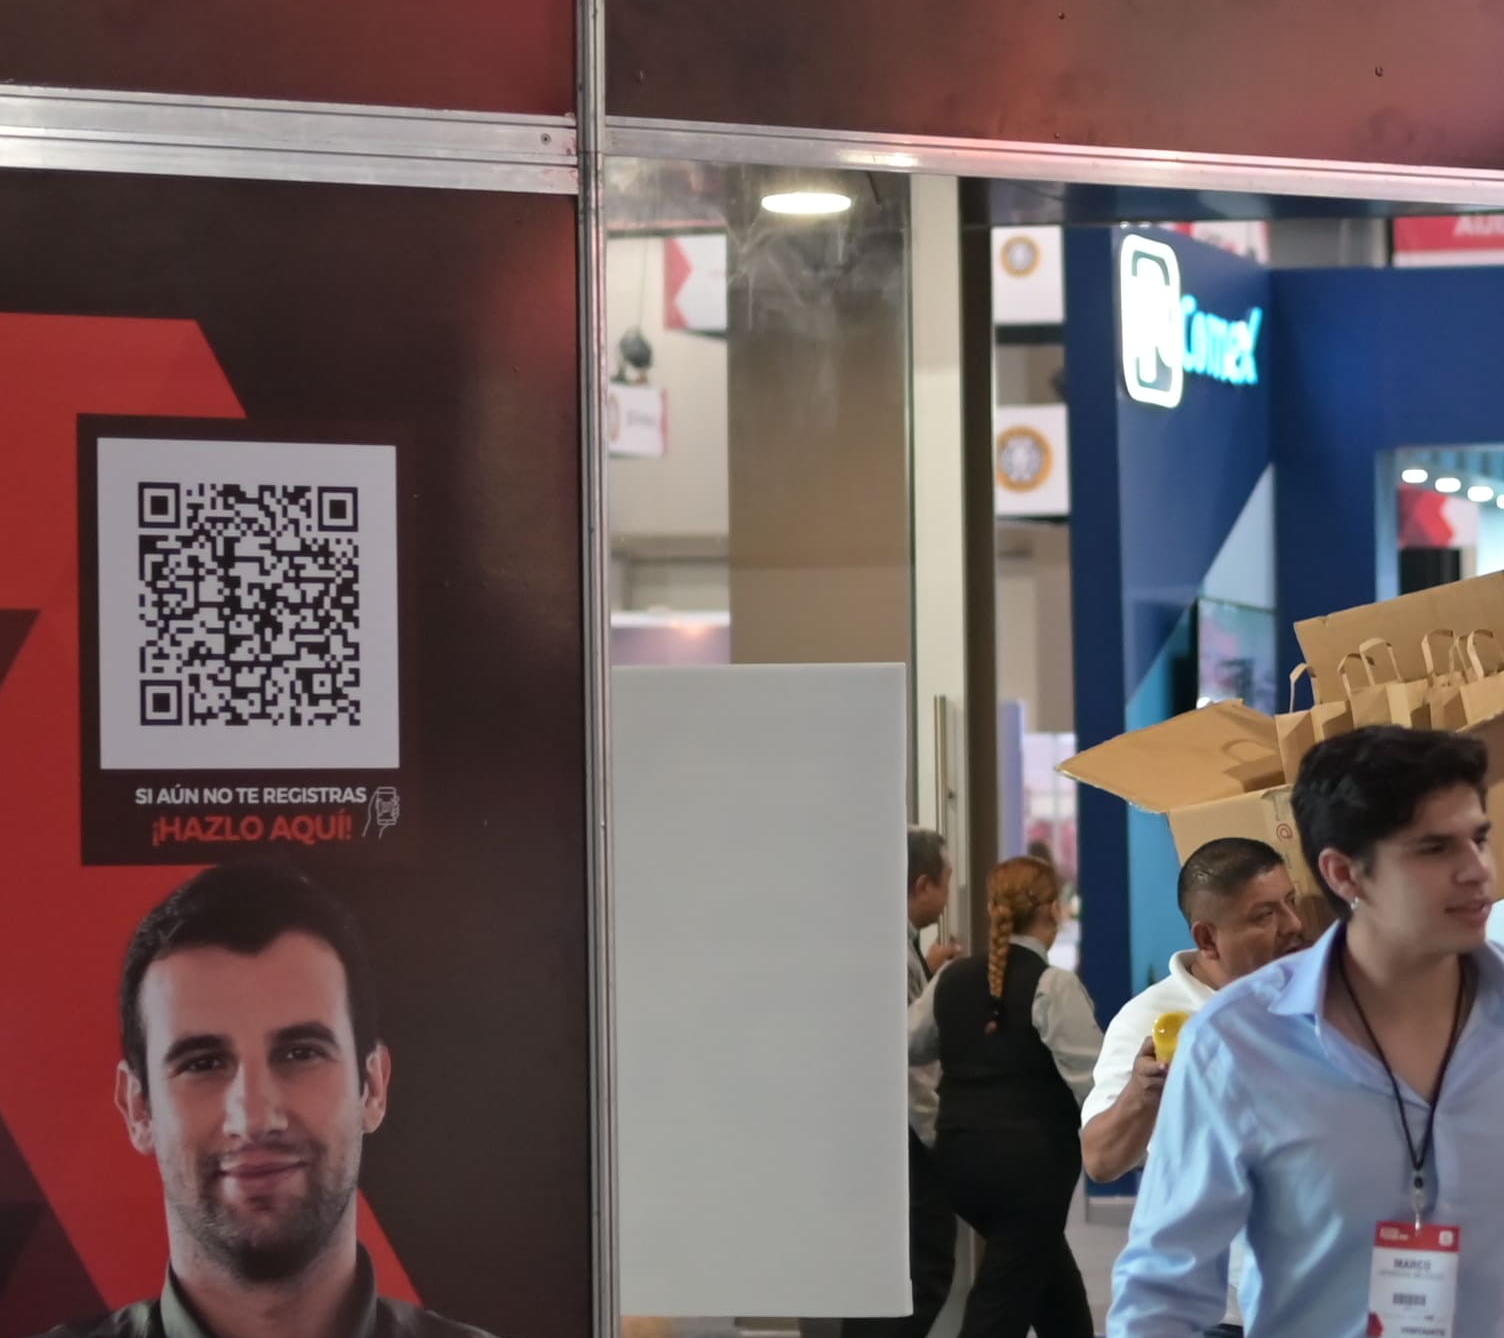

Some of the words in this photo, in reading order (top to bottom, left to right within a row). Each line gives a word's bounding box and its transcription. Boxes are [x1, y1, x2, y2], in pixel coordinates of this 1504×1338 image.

[135, 788, 153, 805] SI
[156, 783, 199, 805] AÚN
[203, 787, 233, 804] NO
[235, 787, 260, 804] TE
[263, 787, 367, 804] REGISTRAS
[153, 815, 264, 846] ¡HAZLO
[270, 809, 352, 844] AQUÍ!
